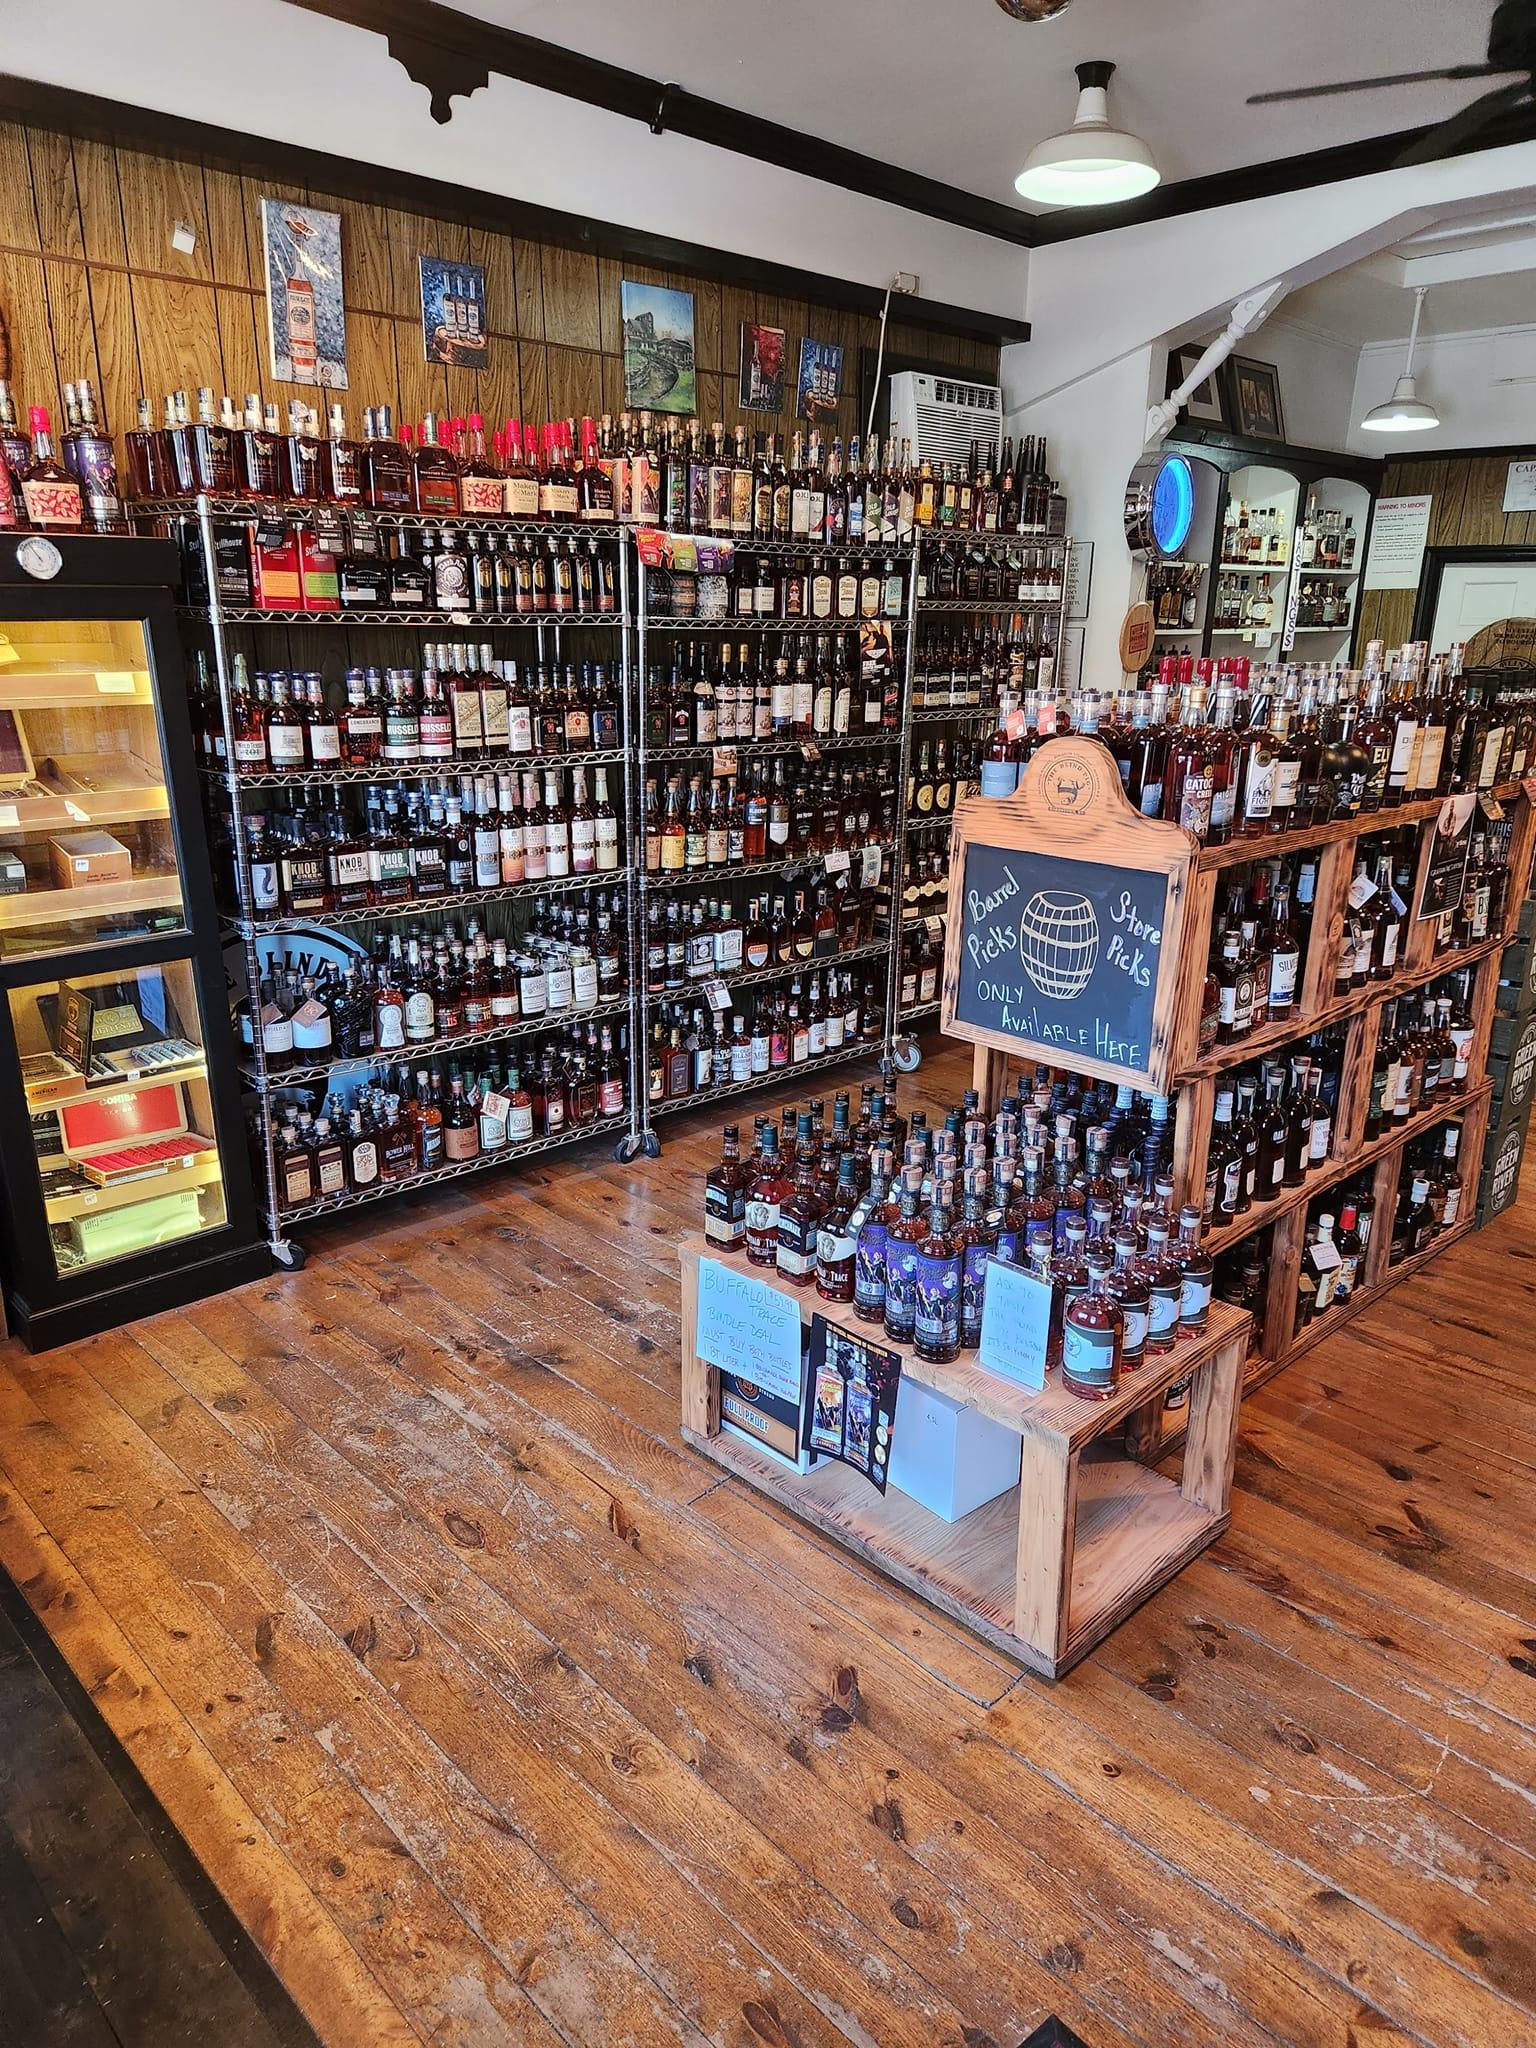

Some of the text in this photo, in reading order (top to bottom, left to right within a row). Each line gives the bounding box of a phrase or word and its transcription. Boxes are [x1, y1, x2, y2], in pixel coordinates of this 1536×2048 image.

[1516, 464, 1536, 473] CAP
[340, 856, 362, 870] KNOB
[380, 852, 404, 866] KNOB
[416, 848, 439, 862] KNOB
[291, 862, 317, 876] KNOB
[345, 866, 366, 874] CREEK
[968, 866, 1020, 924] Barrel
[1110, 891, 1160, 946] Store
[967, 925, 1018, 970] Picks
[1106, 934, 1150, 987] Picks
[978, 980, 1024, 1004] ONLY
[704, 1268, 764, 1304] BUFFALO
[831, 1271, 848, 1282] TRACE
[749, 1305, 788, 1328] TRACE
[750, 1324, 780, 1345] DEAL
[724, 1395, 770, 1434] FULL PROOF
